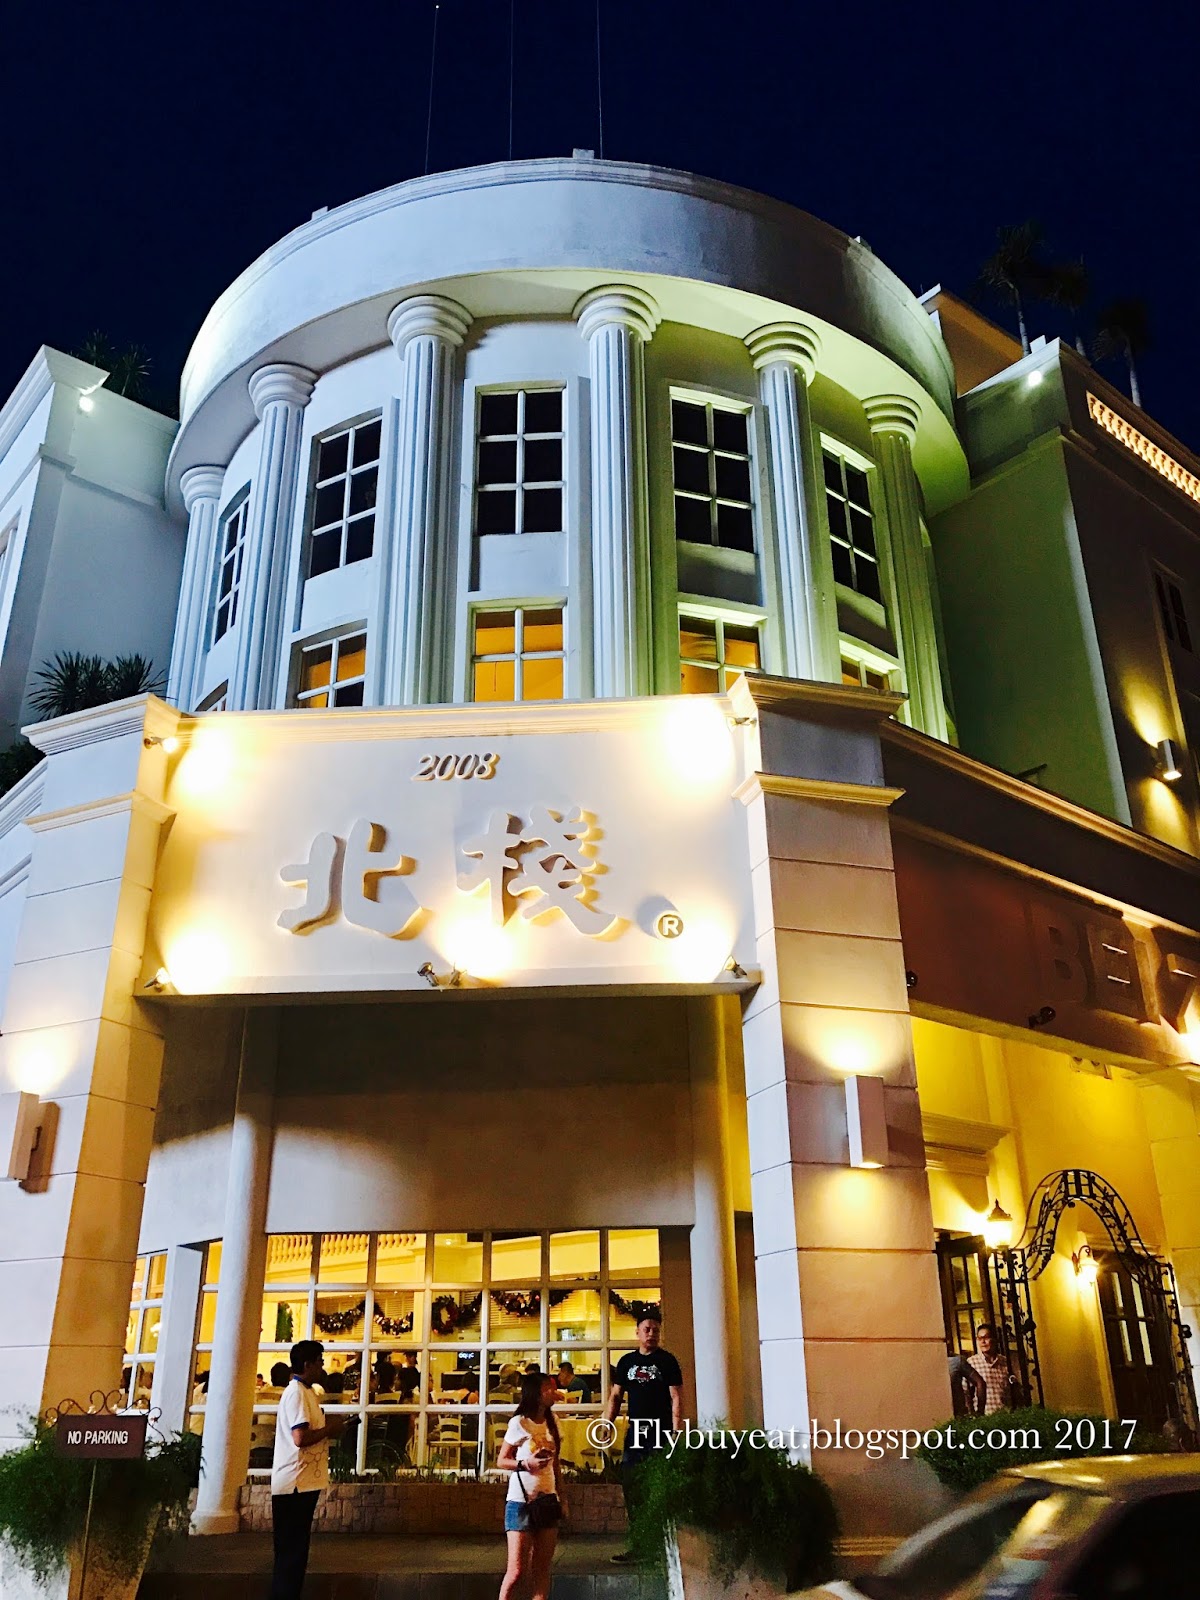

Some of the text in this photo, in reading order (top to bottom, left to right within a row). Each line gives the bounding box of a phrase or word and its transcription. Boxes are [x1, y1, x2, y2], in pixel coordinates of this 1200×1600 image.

[411, 752, 499, 781] 2008
[67, 1430, 129, 1445] NO PARKING
